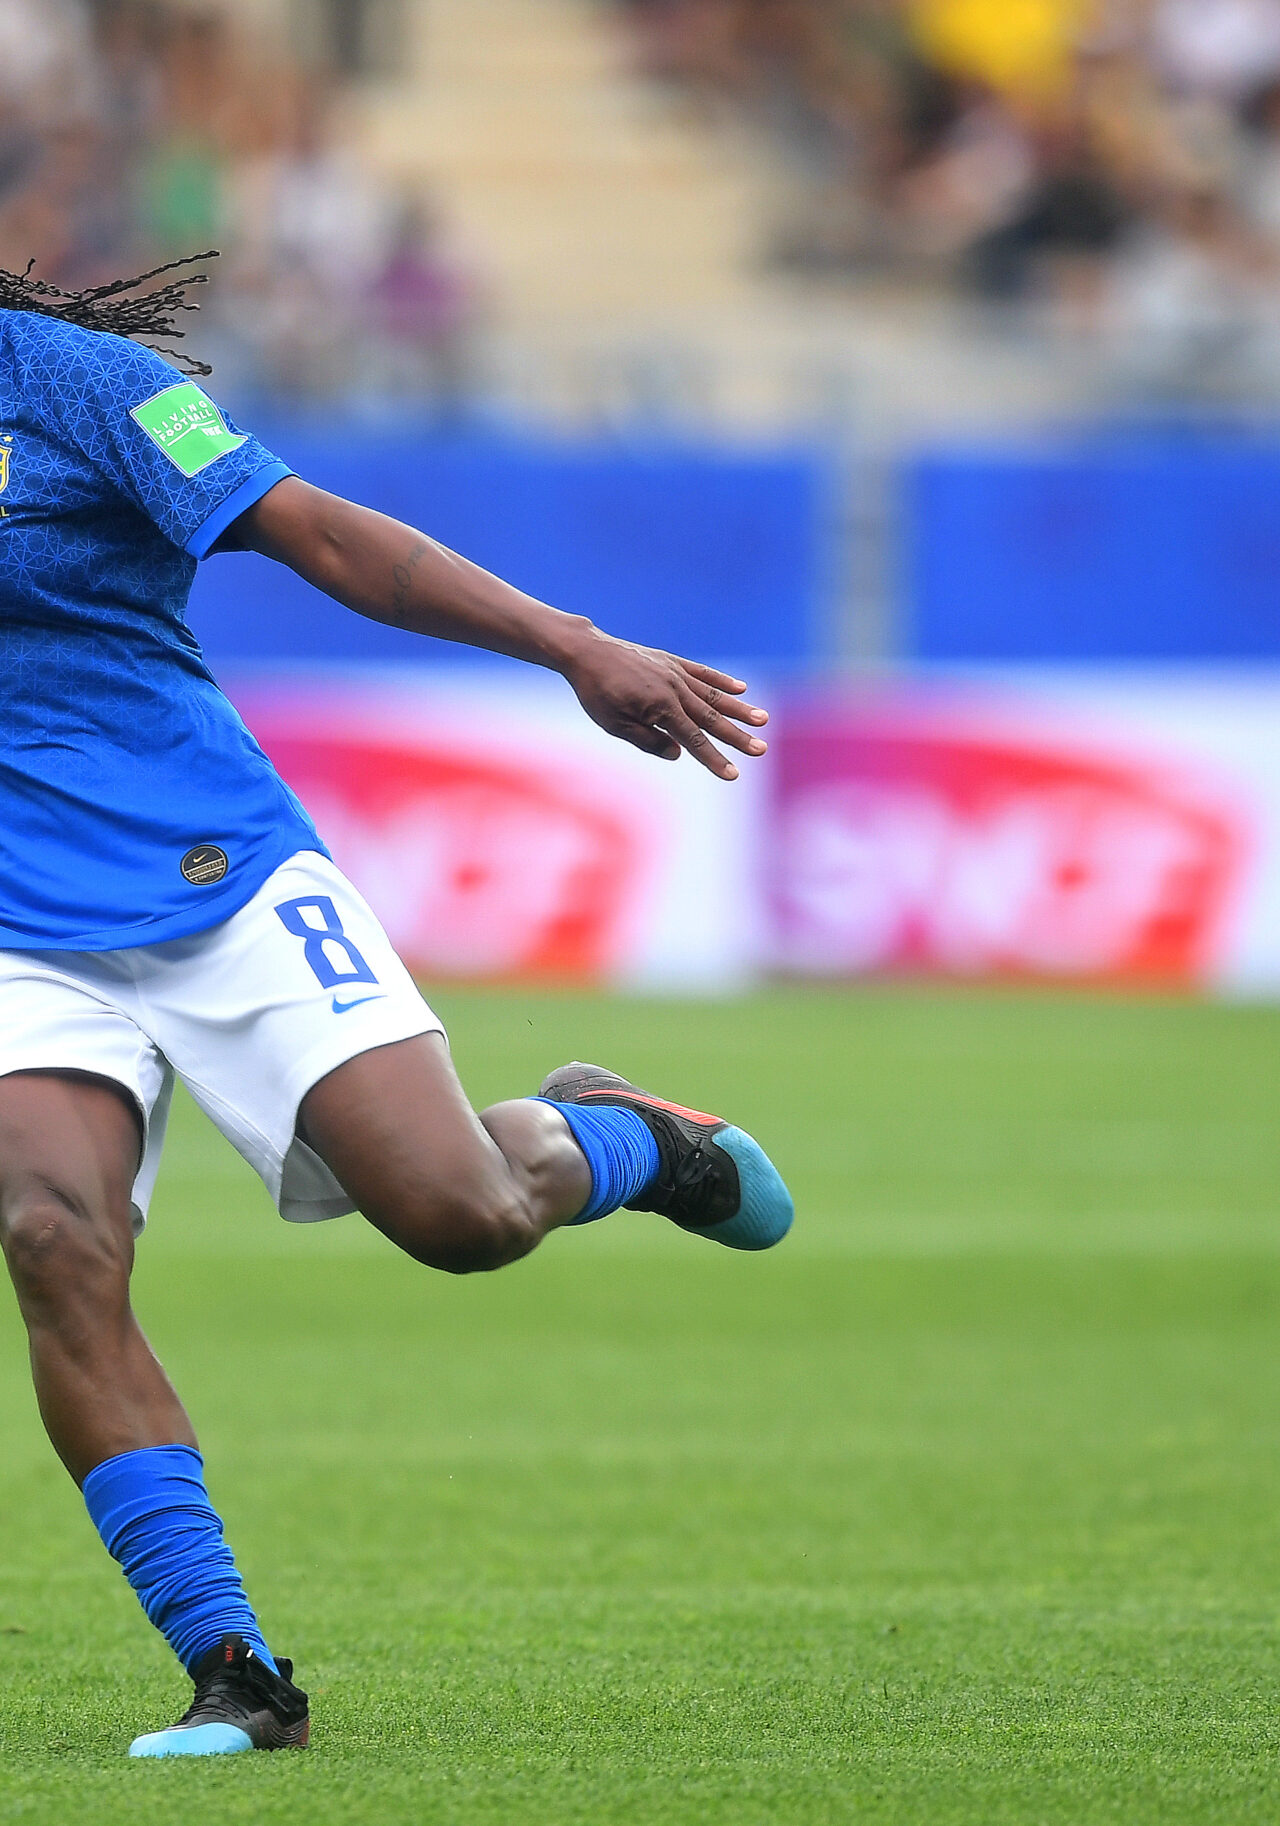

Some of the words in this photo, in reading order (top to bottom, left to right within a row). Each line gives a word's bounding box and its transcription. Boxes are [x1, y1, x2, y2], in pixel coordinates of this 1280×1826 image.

[152, 400, 208, 435] LIVING
[158, 408, 213, 443] FOOTBALL
[273, 895, 379, 989] 8
